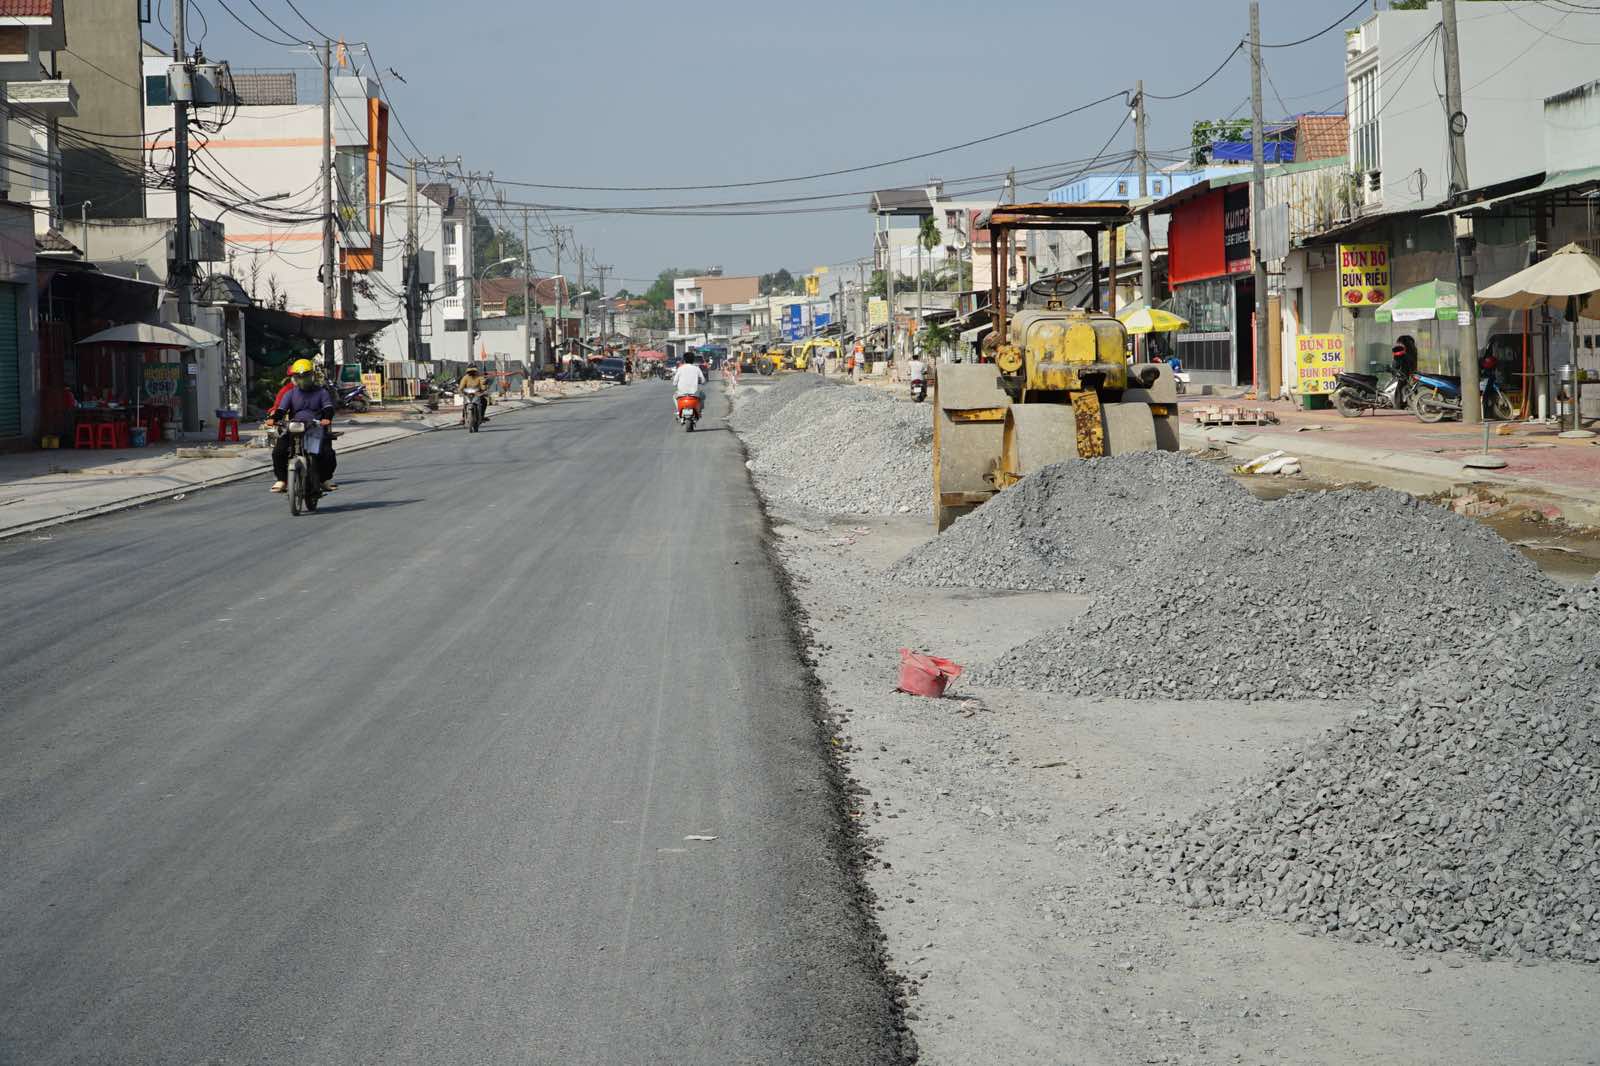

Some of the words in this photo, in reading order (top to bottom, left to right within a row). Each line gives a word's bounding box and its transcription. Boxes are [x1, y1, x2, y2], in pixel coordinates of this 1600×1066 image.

[1343, 248, 1367, 268] BÚN
[1343, 269, 1362, 287] BÚN
[1300, 336, 1324, 351] BÚN
[1328, 336, 1342, 350] BÒ
[1322, 352, 1340, 362] 35K
